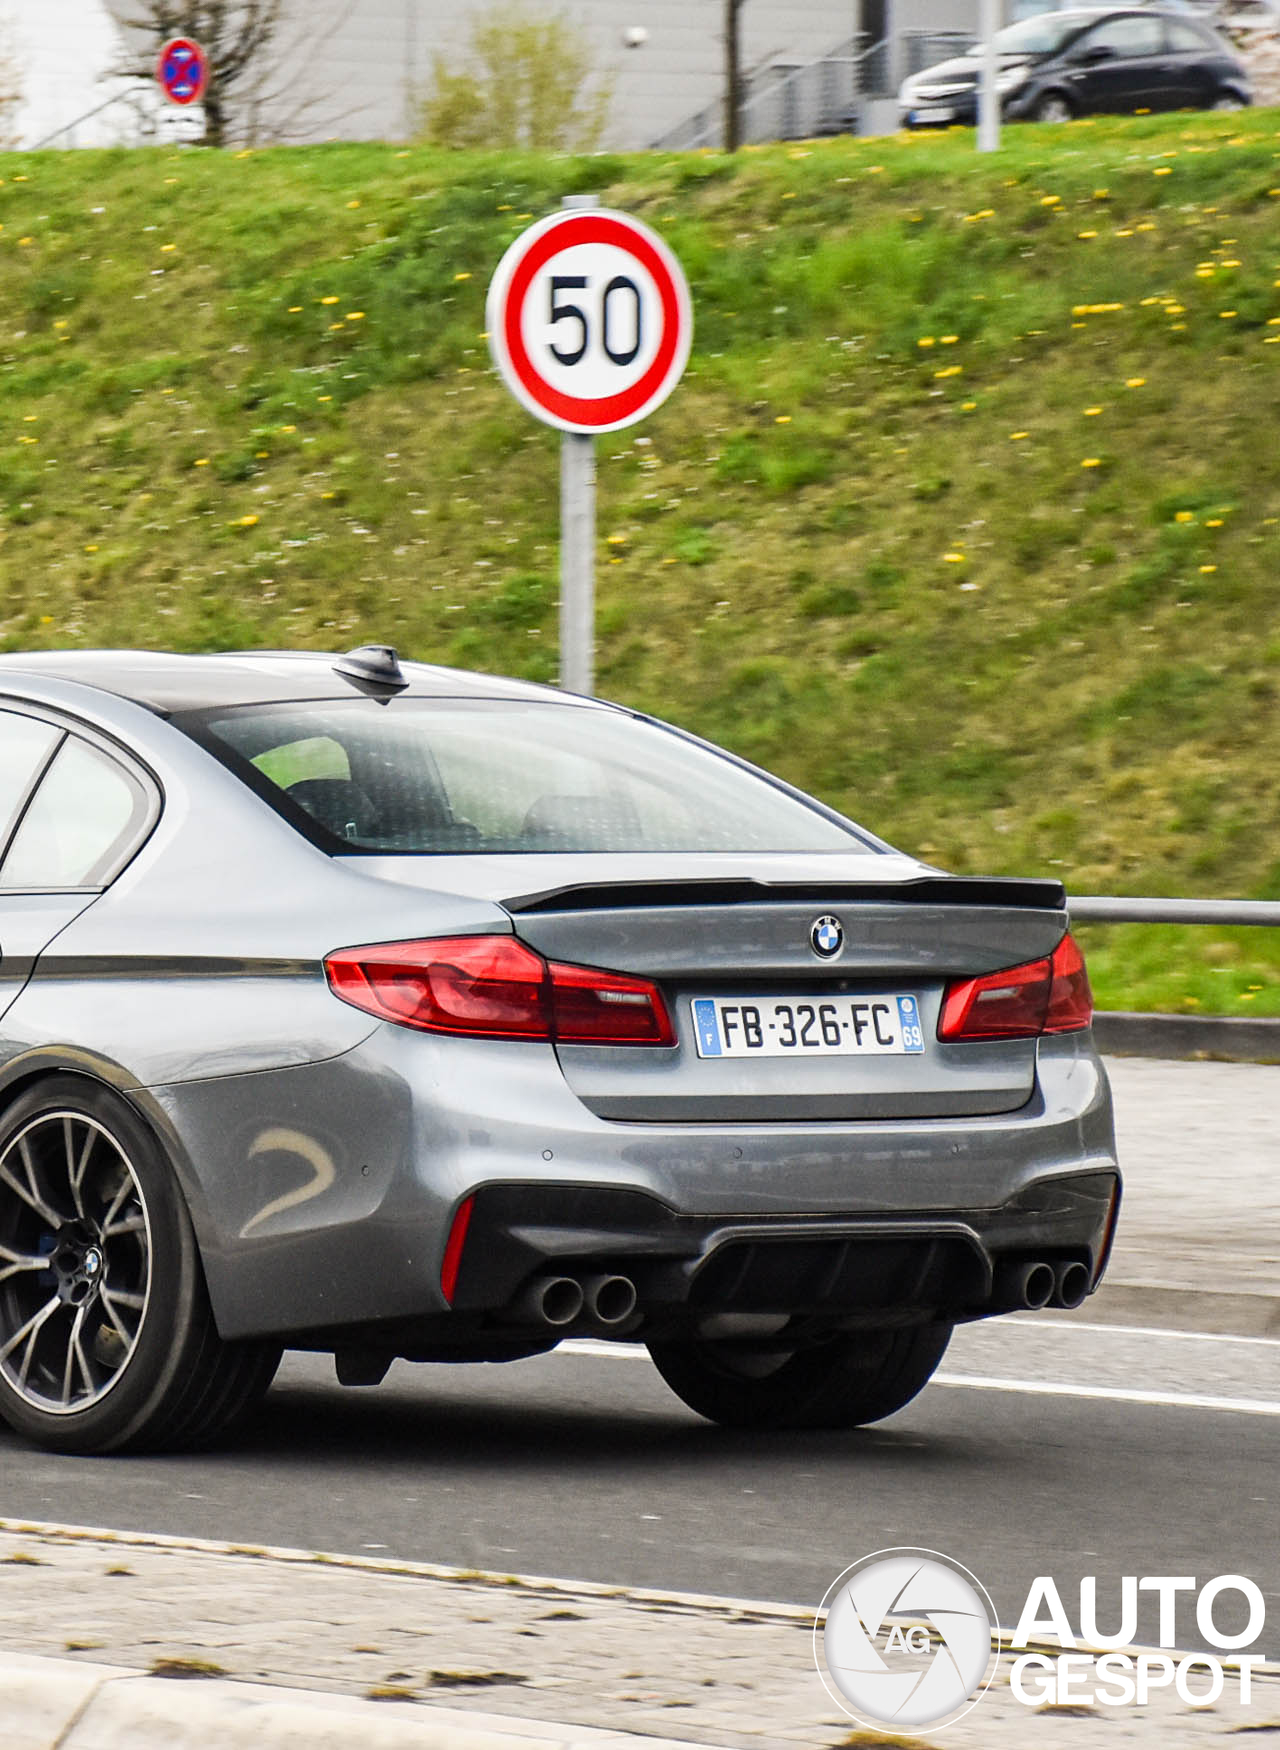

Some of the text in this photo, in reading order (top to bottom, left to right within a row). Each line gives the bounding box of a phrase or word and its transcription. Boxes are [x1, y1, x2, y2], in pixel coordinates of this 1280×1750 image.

[547, 275, 641, 366] 50
[705, 1033, 713, 1047] F
[720, 1003, 894, 1048] FB-326-FC
[903, 1025, 921, 1047] 69
